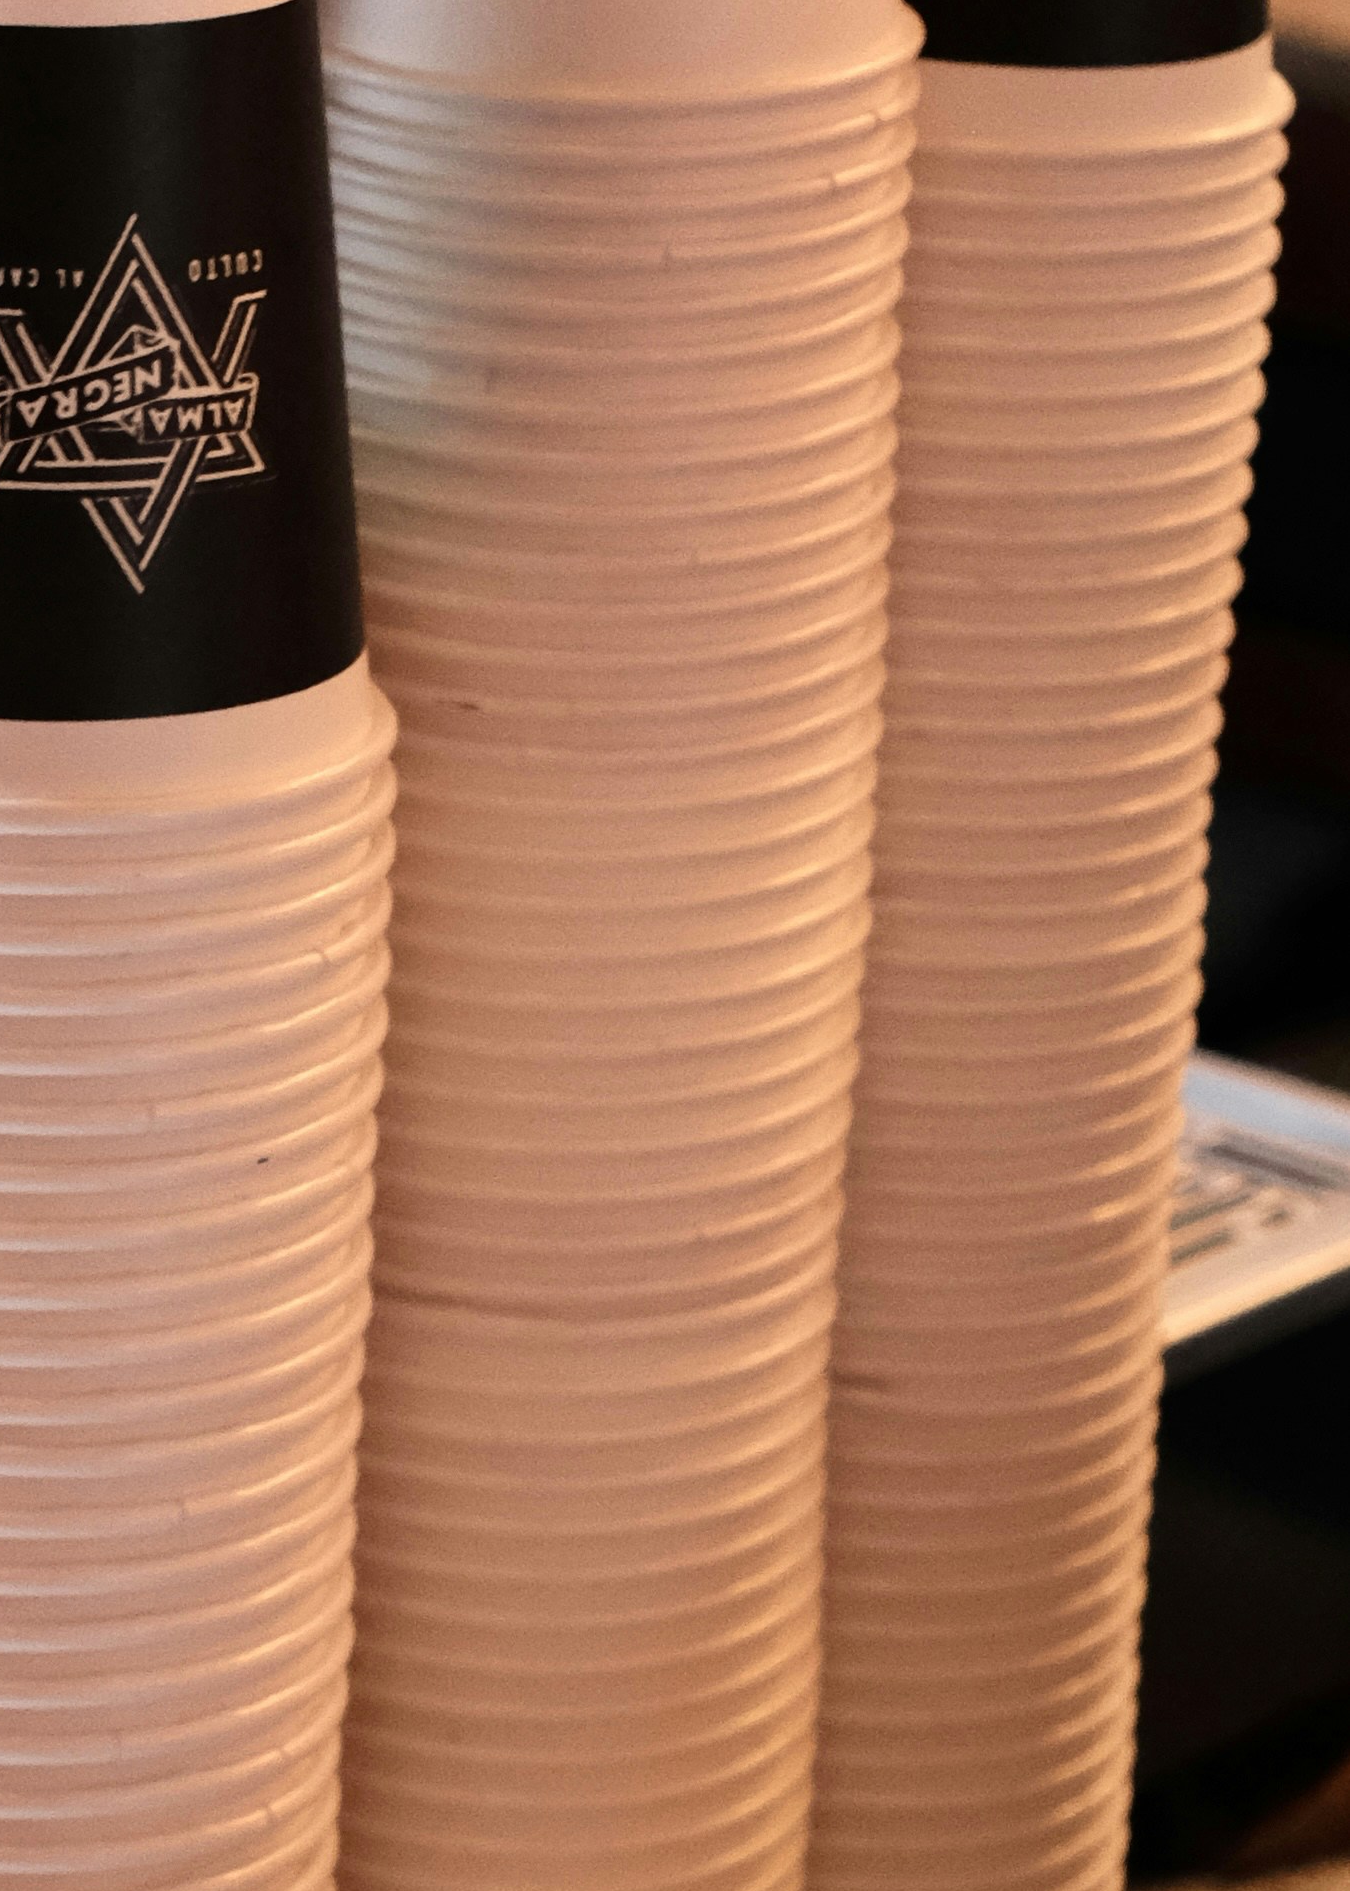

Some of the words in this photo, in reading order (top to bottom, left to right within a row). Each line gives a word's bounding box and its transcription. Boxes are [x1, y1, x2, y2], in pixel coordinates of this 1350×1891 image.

[56, 267, 84, 288] AL
[188, 249, 264, 282] CULTO
[17, 358, 163, 429] NEGRA
[148, 398, 246, 435] ALMA
